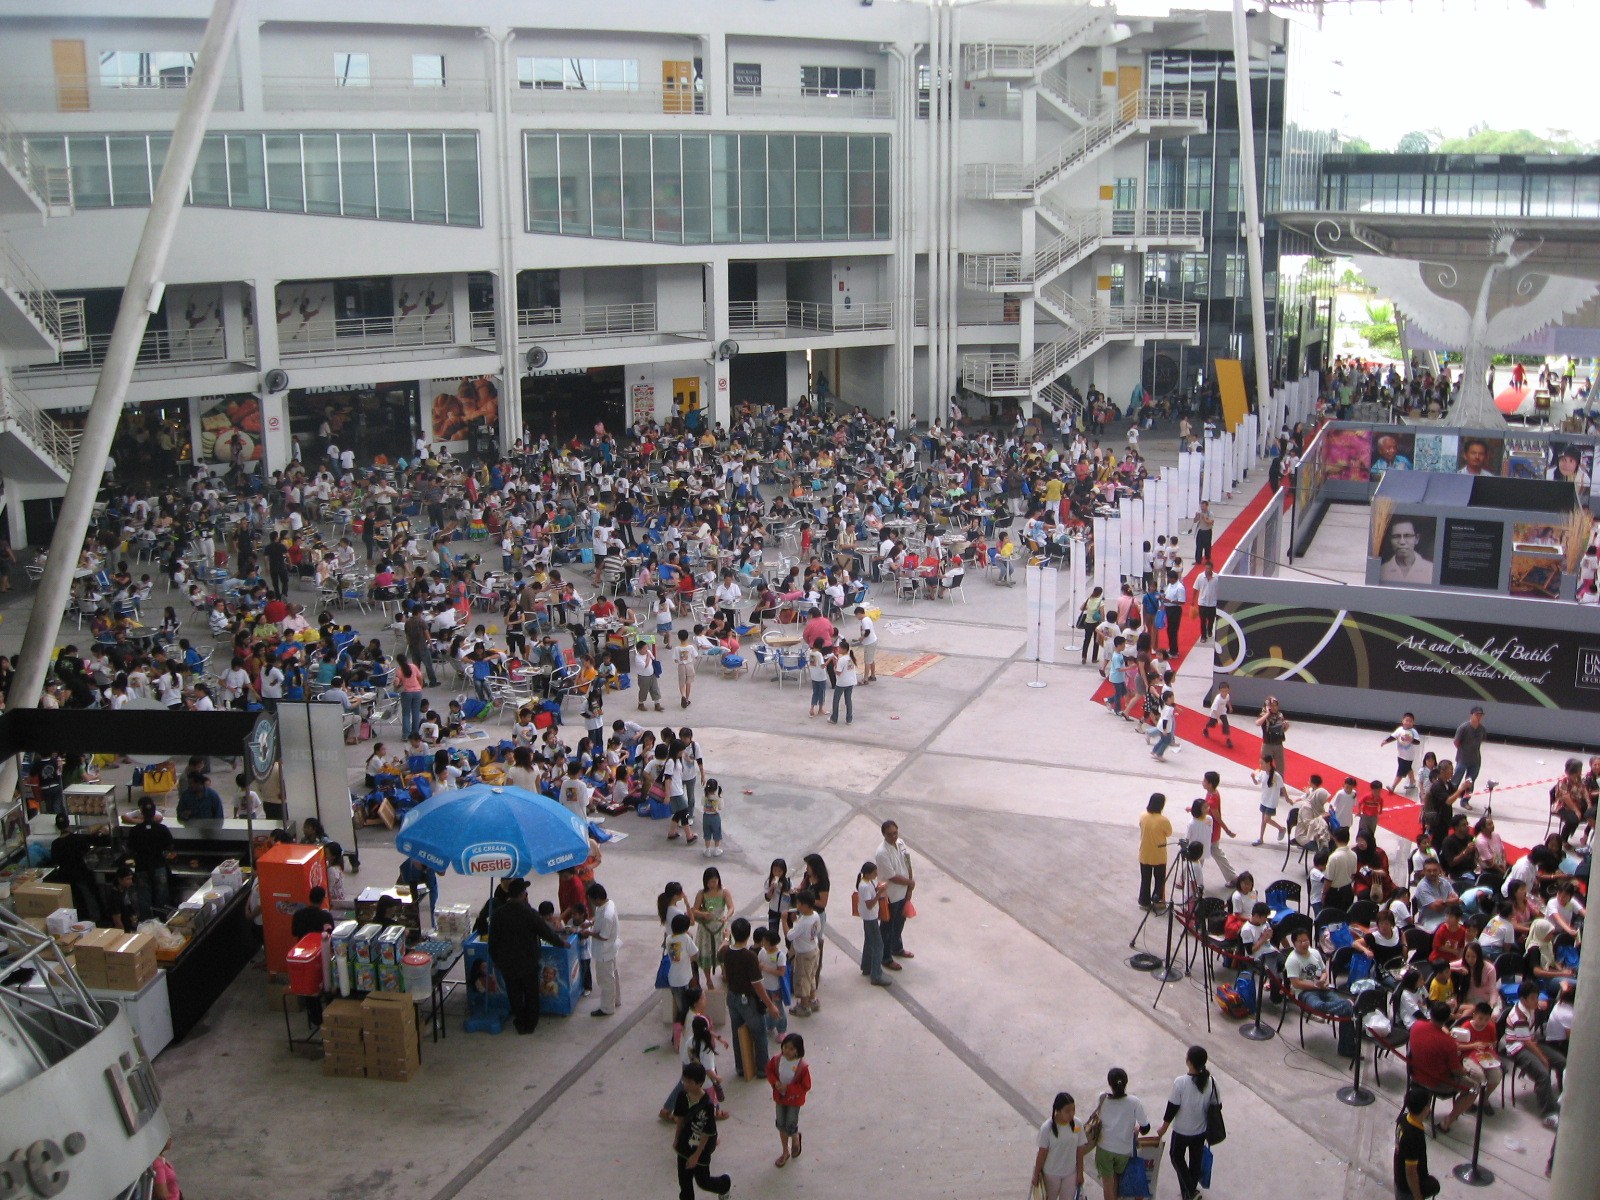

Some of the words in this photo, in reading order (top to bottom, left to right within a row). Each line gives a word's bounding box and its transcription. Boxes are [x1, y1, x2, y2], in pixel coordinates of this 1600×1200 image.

[1396, 635, 1427, 650] Art
[1429, 634, 1464, 654] and
[1456, 637, 1495, 656] Soul
[1510, 645, 1559, 663] Batik
[1395, 660, 1450, 674] Remembered
[1451, 664, 1502, 680] Celebrated
[1502, 671, 1551, 685] Honoured
[483, 845, 507, 853] CREAM
